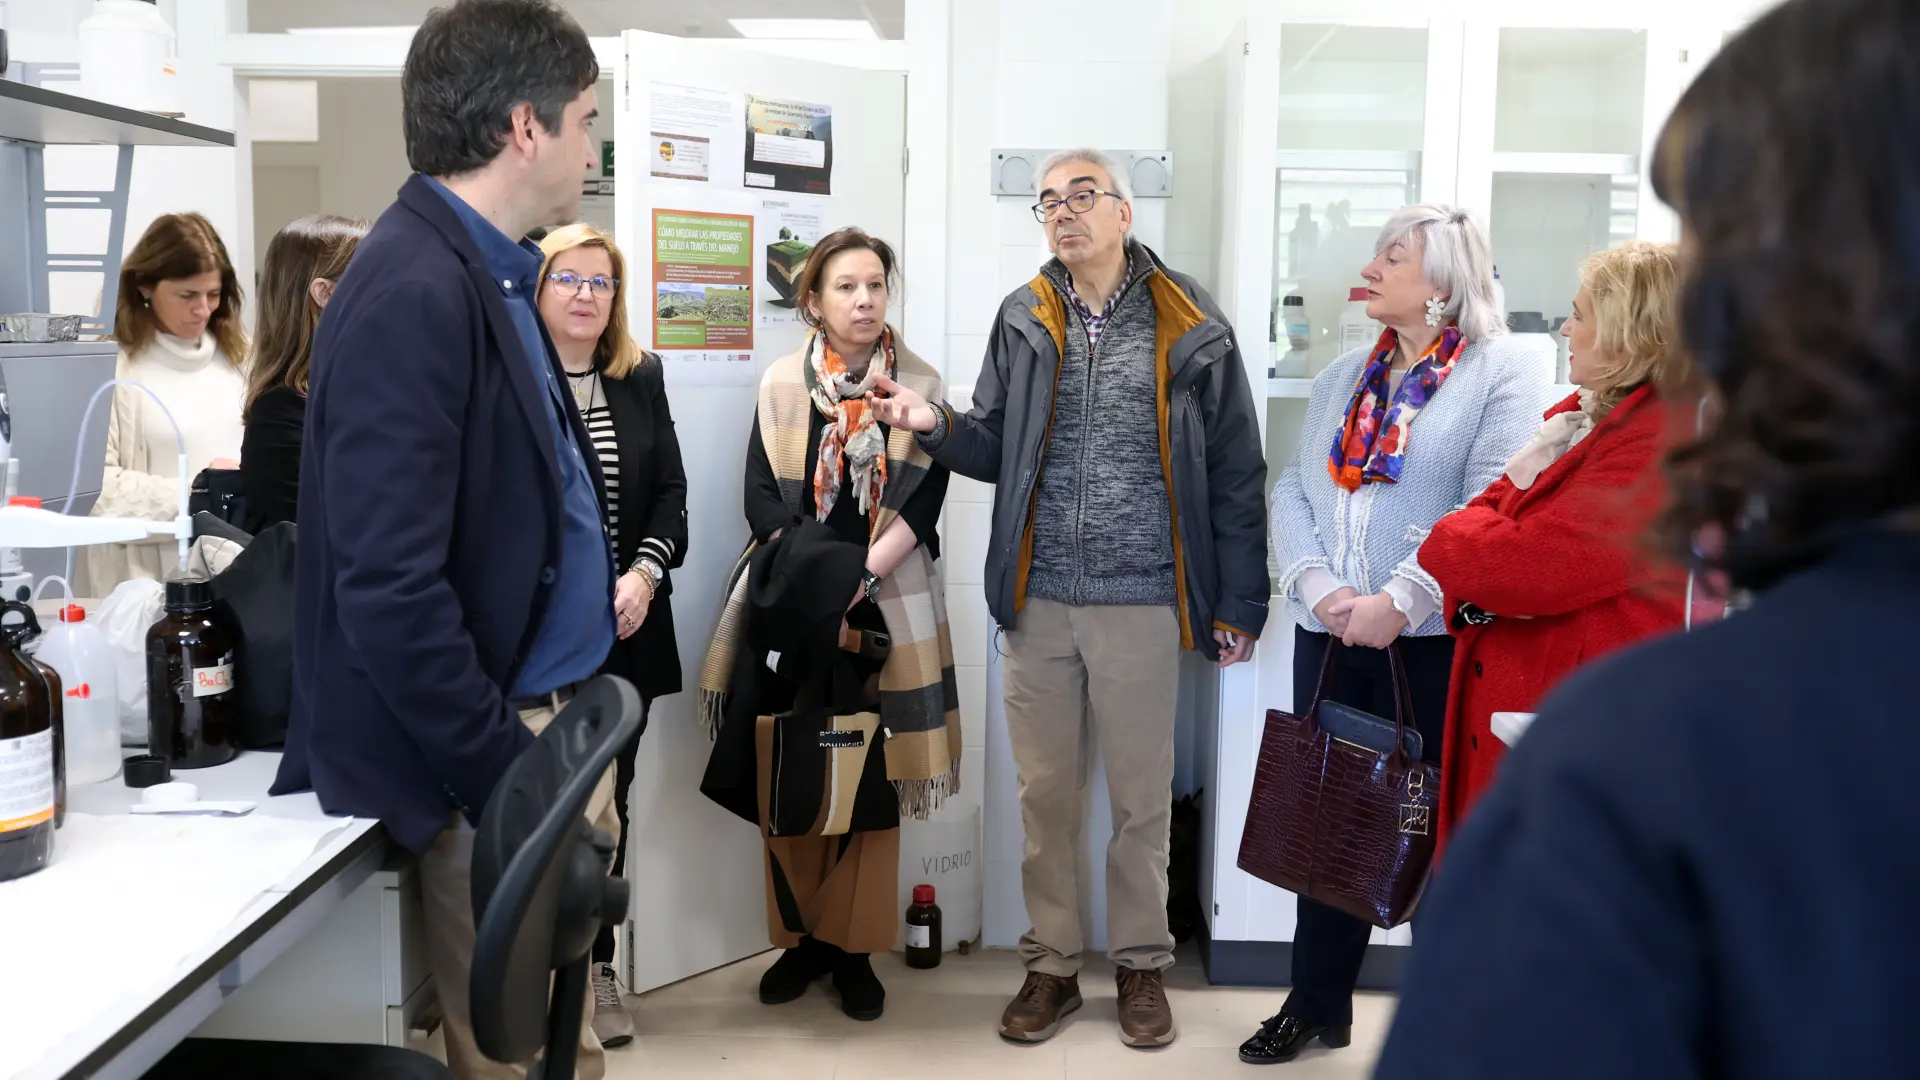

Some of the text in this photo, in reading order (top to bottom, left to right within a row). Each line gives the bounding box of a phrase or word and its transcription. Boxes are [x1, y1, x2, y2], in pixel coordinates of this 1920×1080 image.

[675, 228, 698, 240] MEJORAR
[699, 230, 709, 240] LAS
[709, 230, 743, 242] PROPIEDADES
[658, 240, 668, 250] DEL
[669, 241, 684, 251] SUELO
[690, 240, 708, 252] TRAVÉS
[709, 242, 718, 252] DEL
[719, 243, 739, 255] MANEJO
